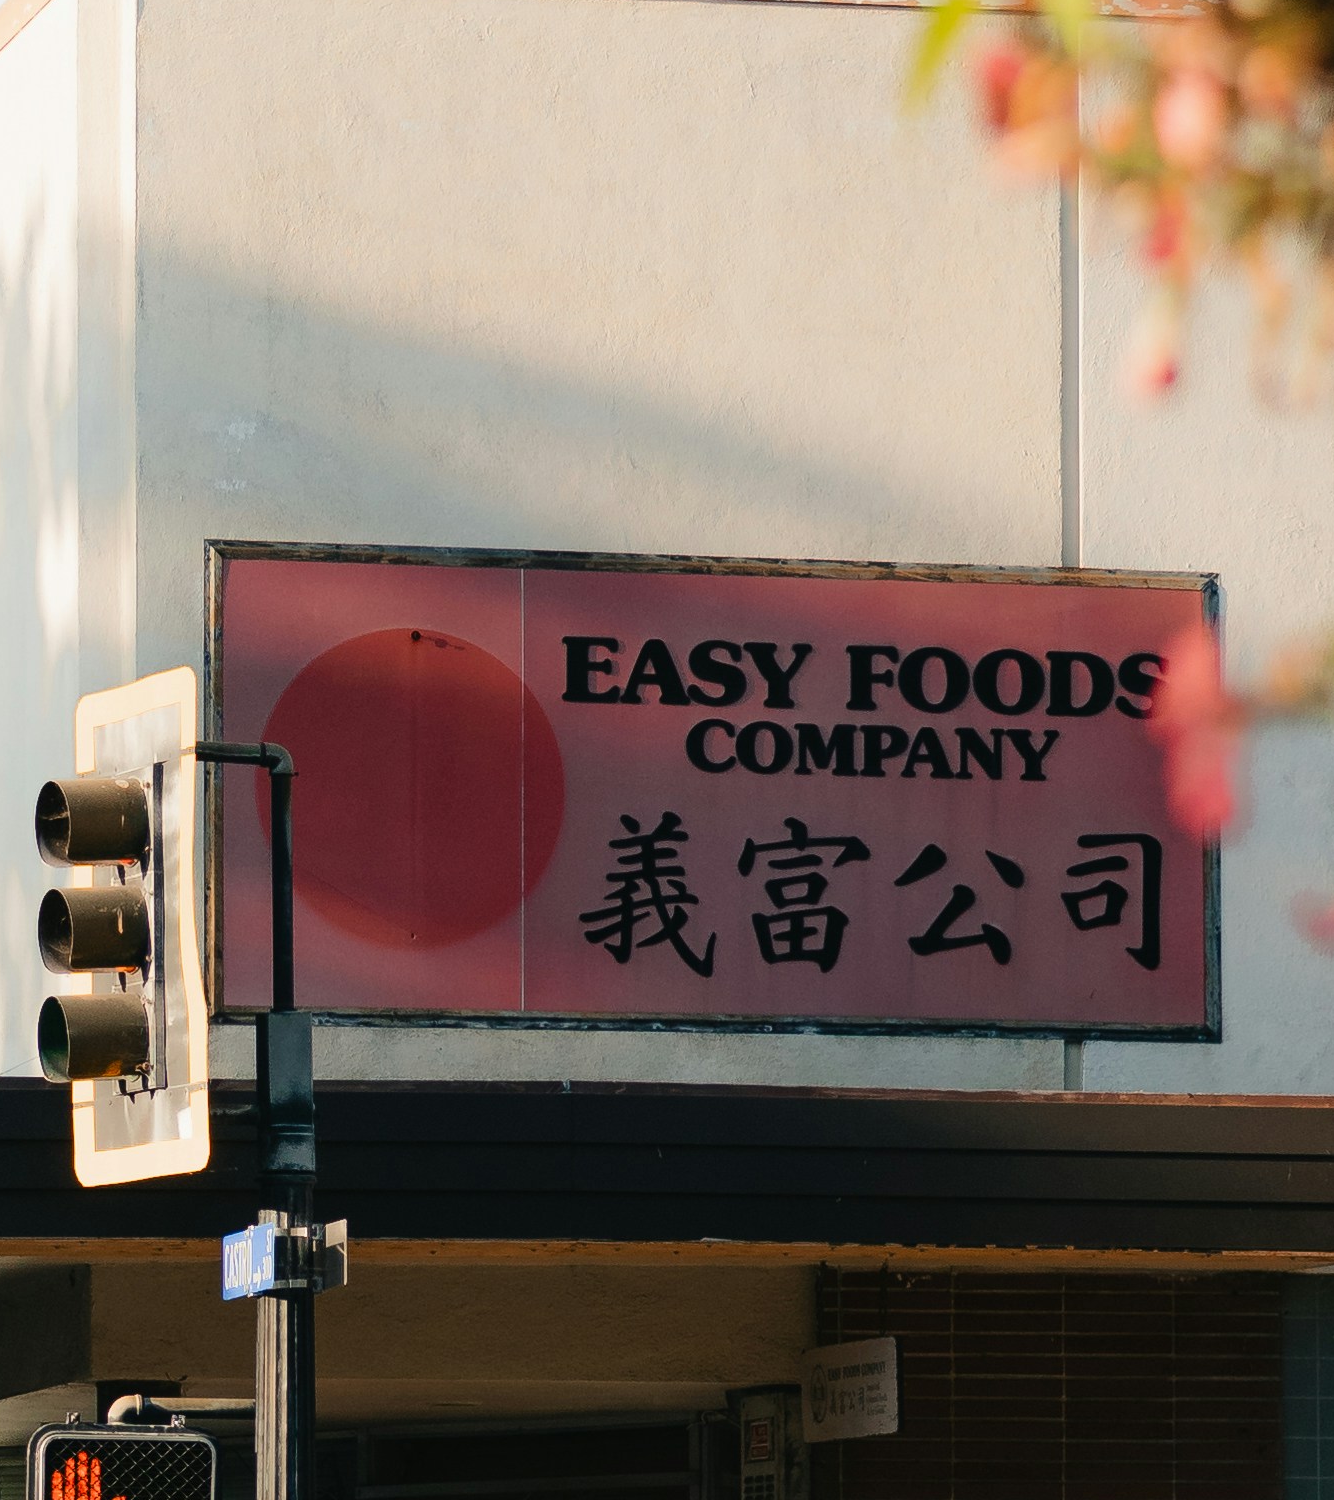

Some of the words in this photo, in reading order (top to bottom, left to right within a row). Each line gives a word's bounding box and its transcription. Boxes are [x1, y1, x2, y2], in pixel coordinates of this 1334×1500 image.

[560, 636, 813, 708] EASY
[845, 644, 1170, 720] FOODS
[685, 717, 1060, 782] COMPANY
[578, 812, 1163, 978] 義富公司
[224, 1239, 252, 1290] CASTRO
